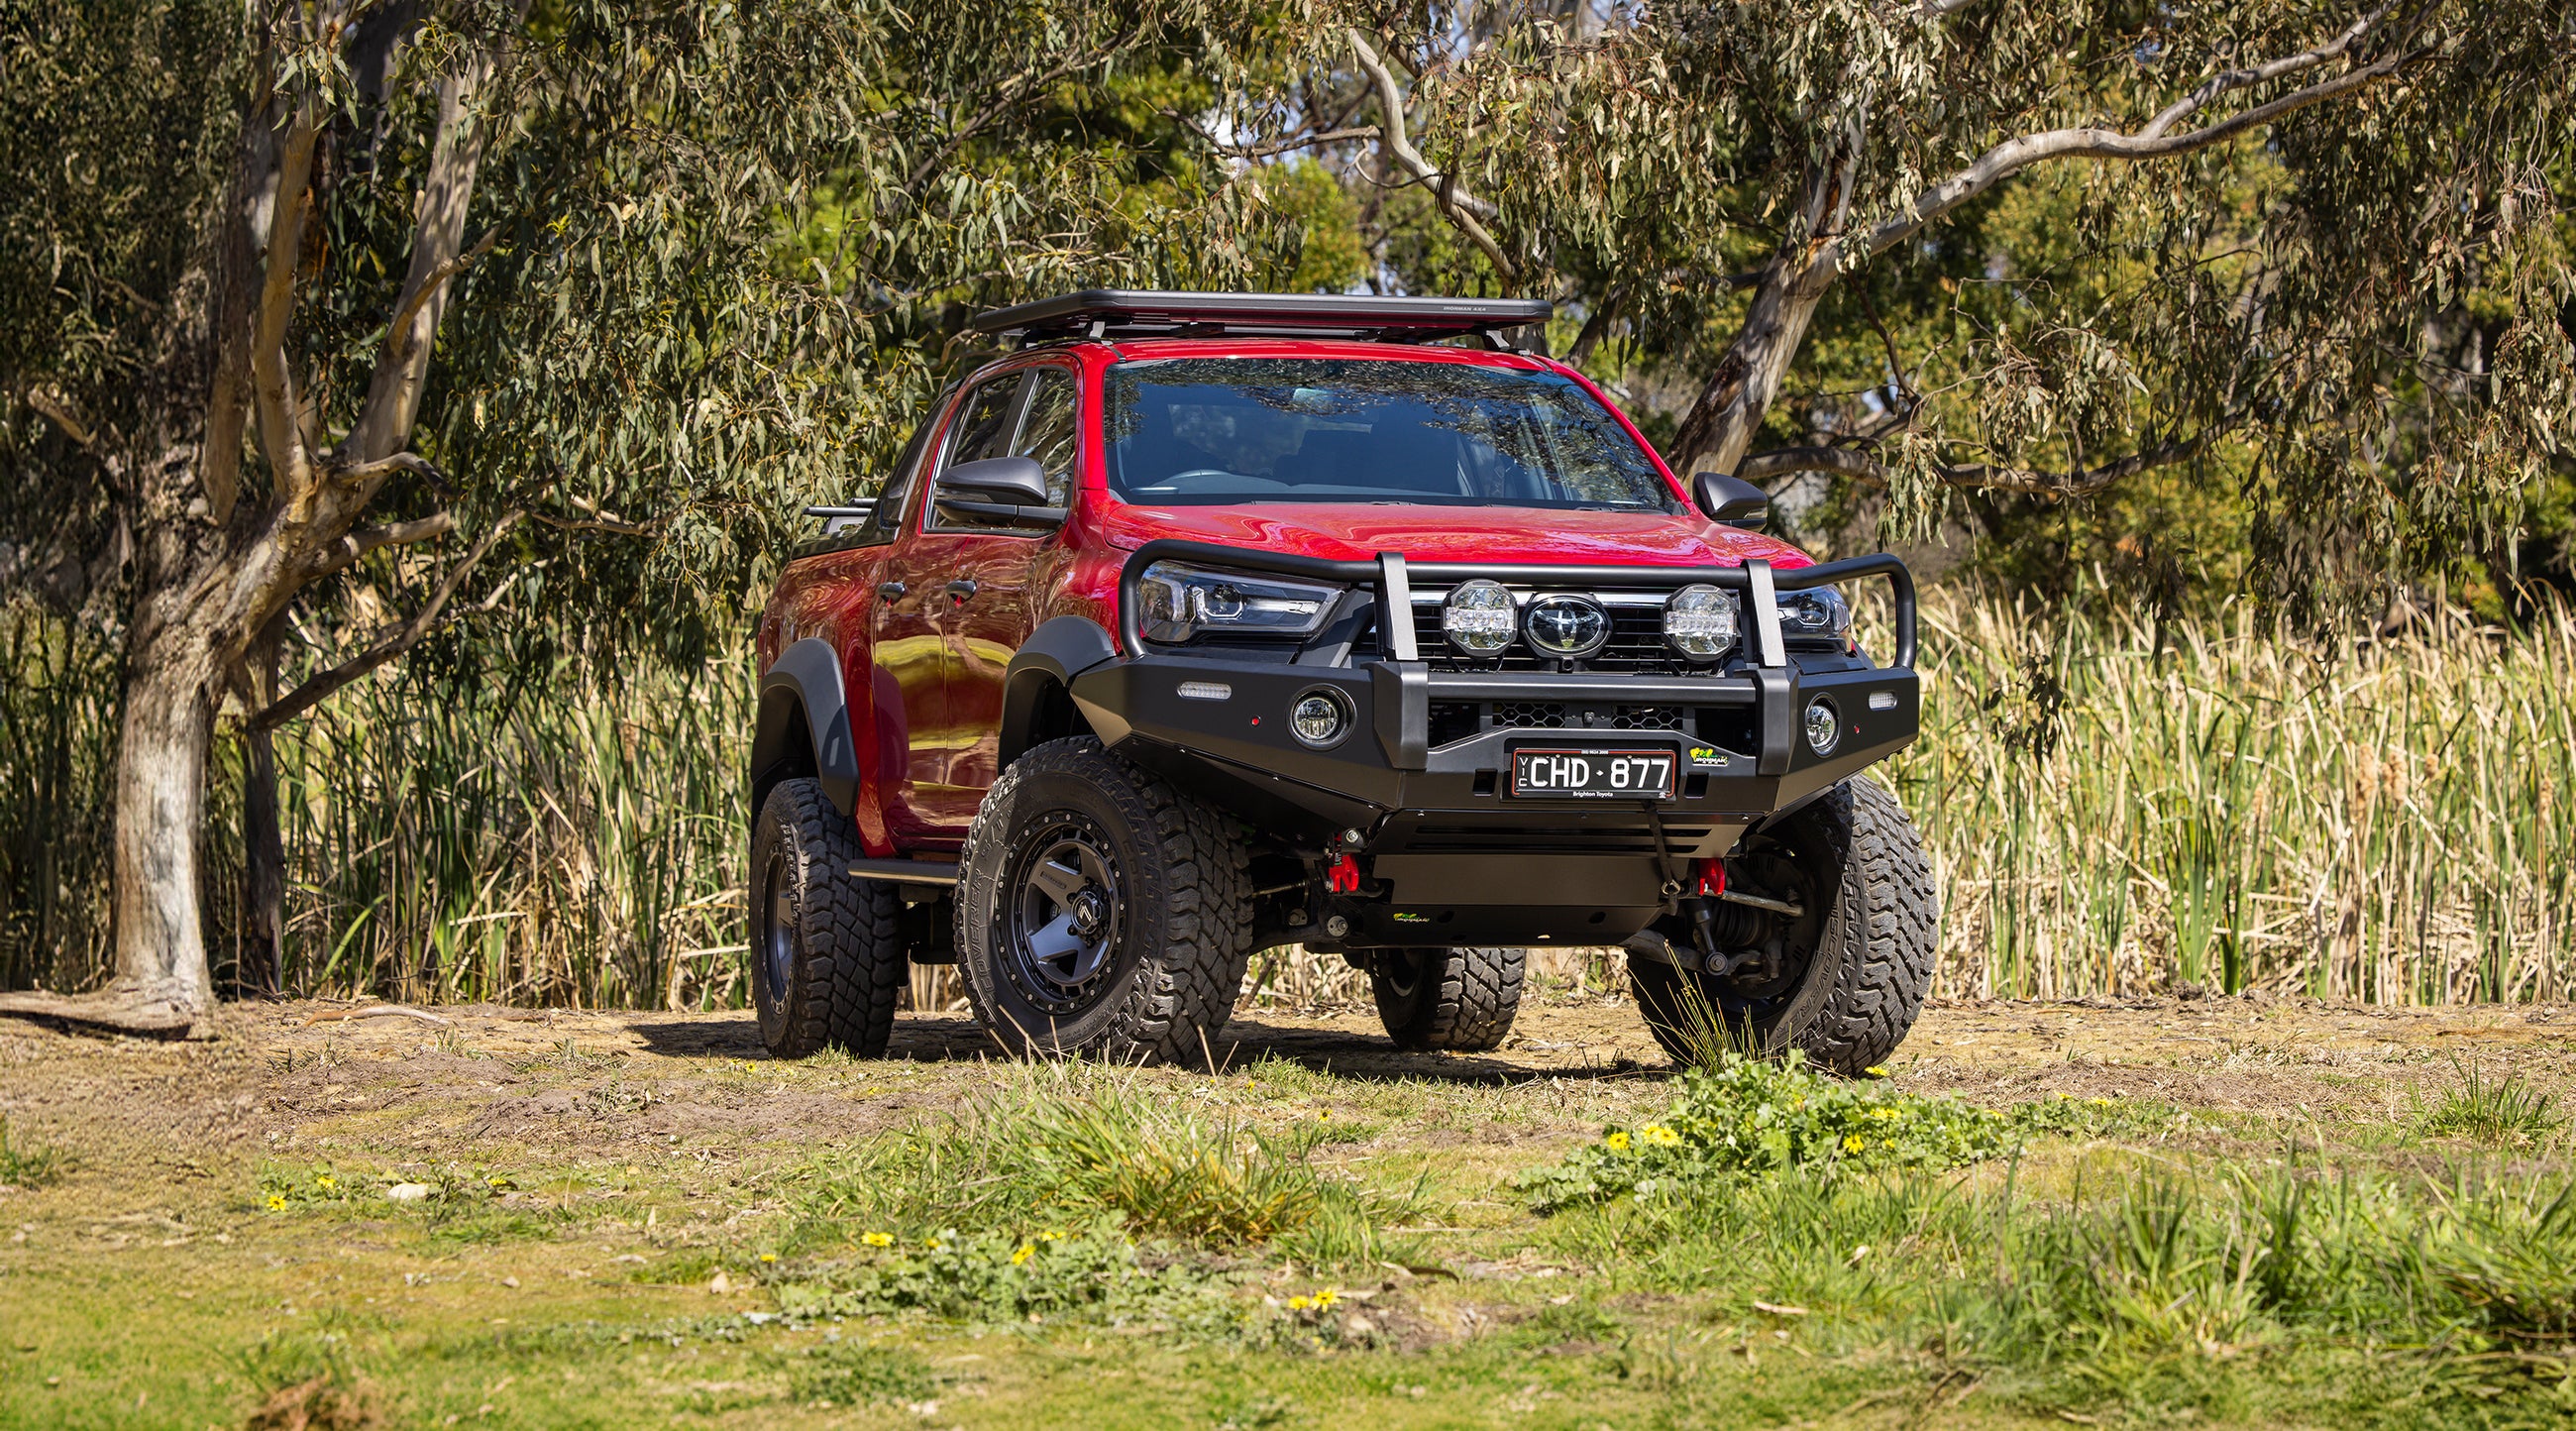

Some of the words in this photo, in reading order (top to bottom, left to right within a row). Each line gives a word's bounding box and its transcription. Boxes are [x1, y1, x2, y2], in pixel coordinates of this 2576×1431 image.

[1518, 756, 1529, 787] VIC
[1530, 756, 1590, 788] CHD
[1610, 757, 1670, 789] 877
